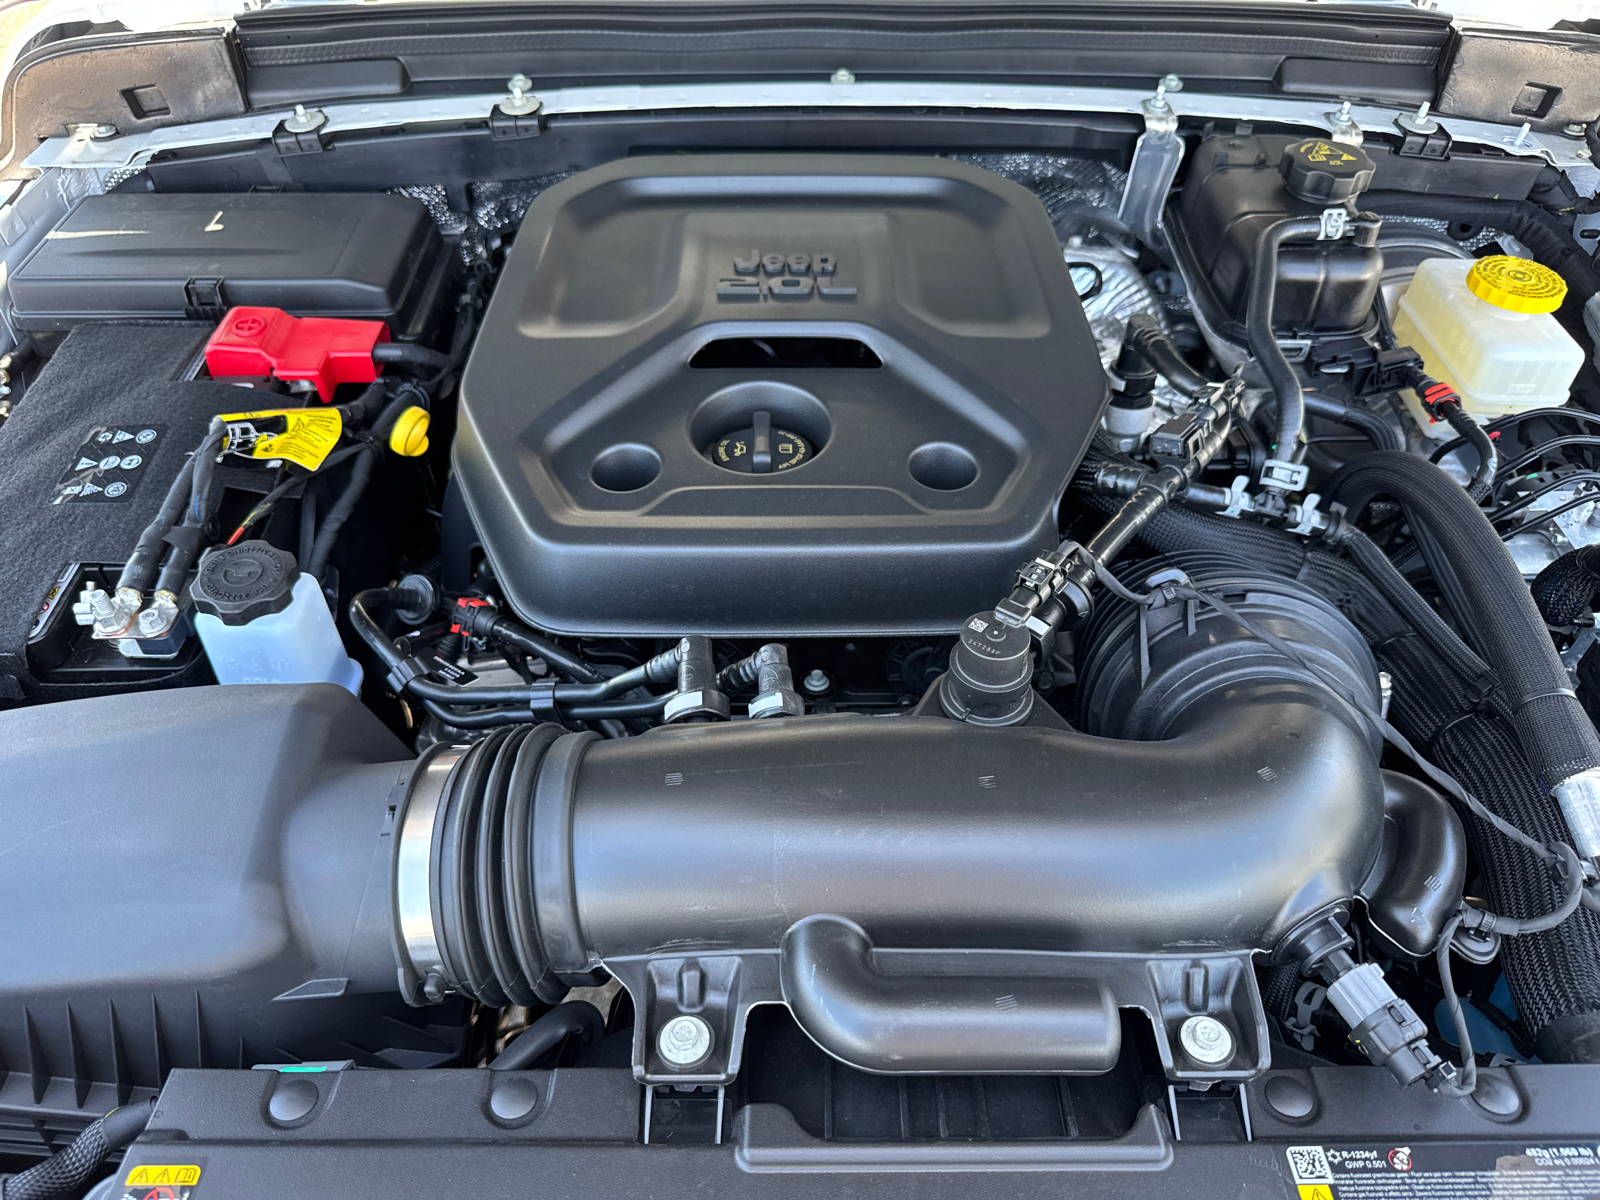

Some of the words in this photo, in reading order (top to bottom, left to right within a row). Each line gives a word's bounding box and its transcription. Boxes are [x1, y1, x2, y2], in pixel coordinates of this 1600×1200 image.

[733, 249, 838, 277] Jeep
[717, 276, 858, 301] 2.0L
[206, 583, 250, 600] APPROVED
[1345, 1160, 1365, 1169] GWP
[1365, 1160, 1387, 1169] 0.501
